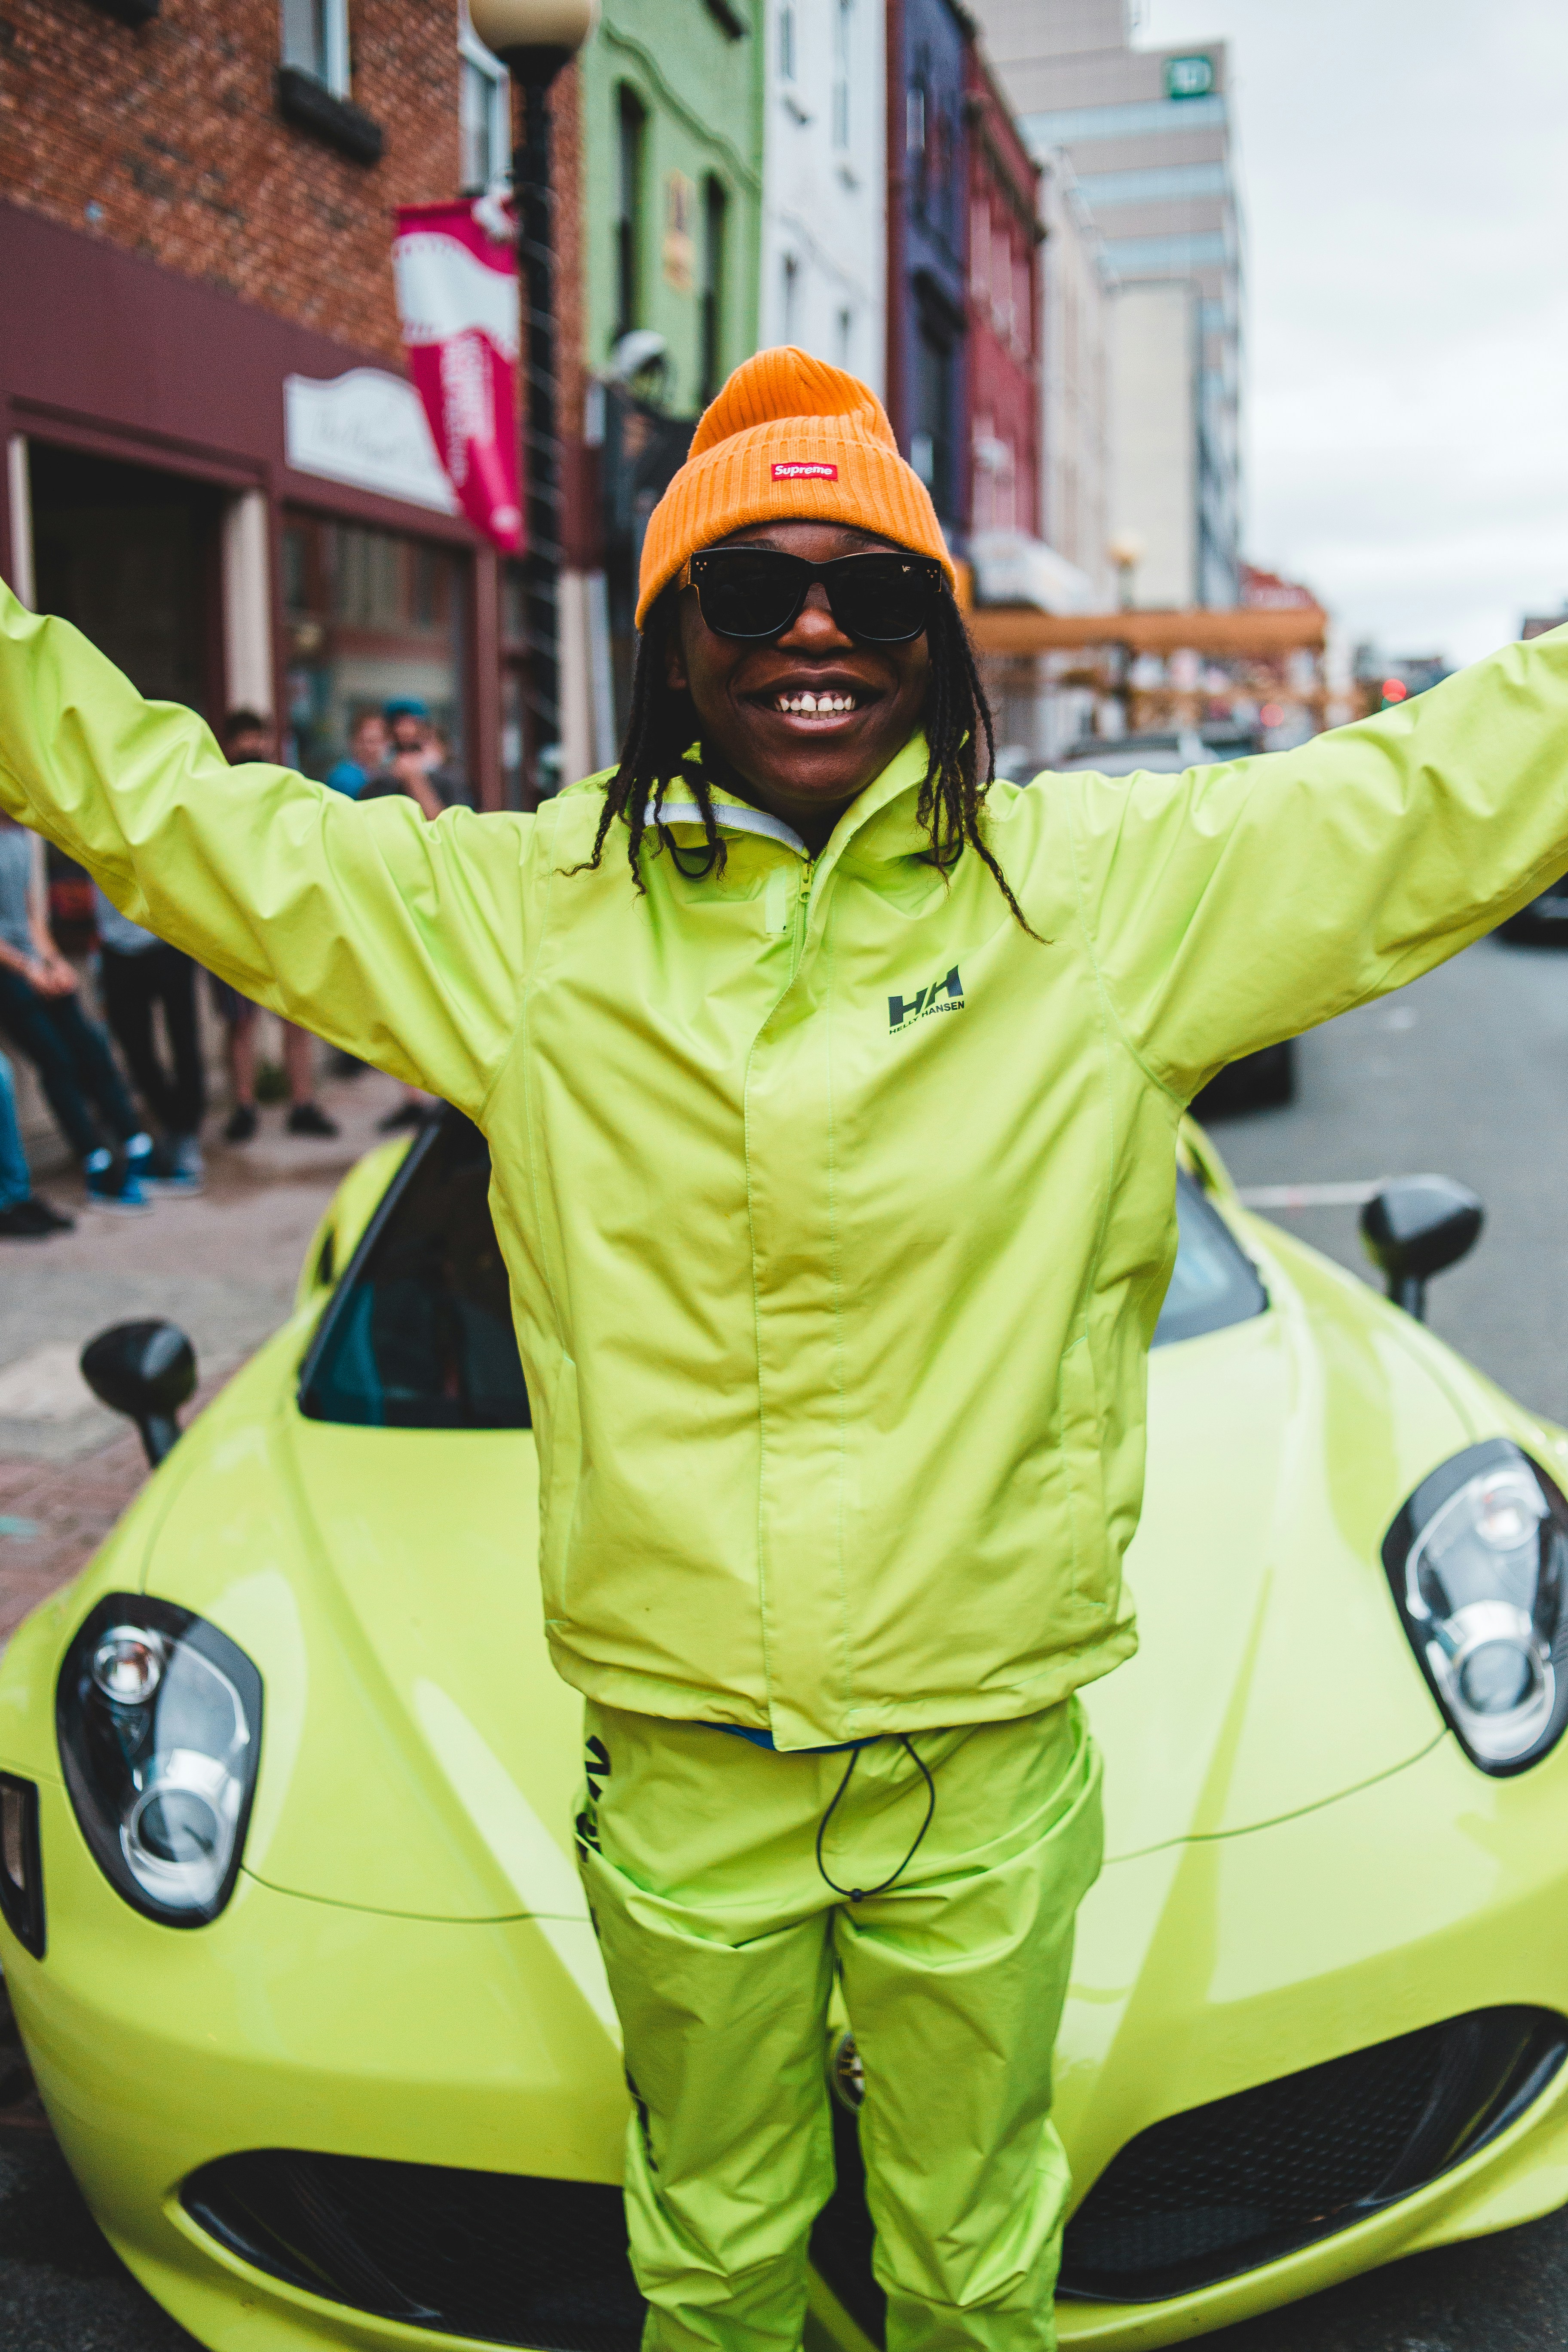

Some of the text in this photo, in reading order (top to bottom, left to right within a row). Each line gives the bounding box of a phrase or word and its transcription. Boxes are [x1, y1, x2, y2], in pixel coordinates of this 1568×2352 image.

[775, 466, 833, 476] Supreme
[889, 1001, 964, 1035] HELLY HANSEN
